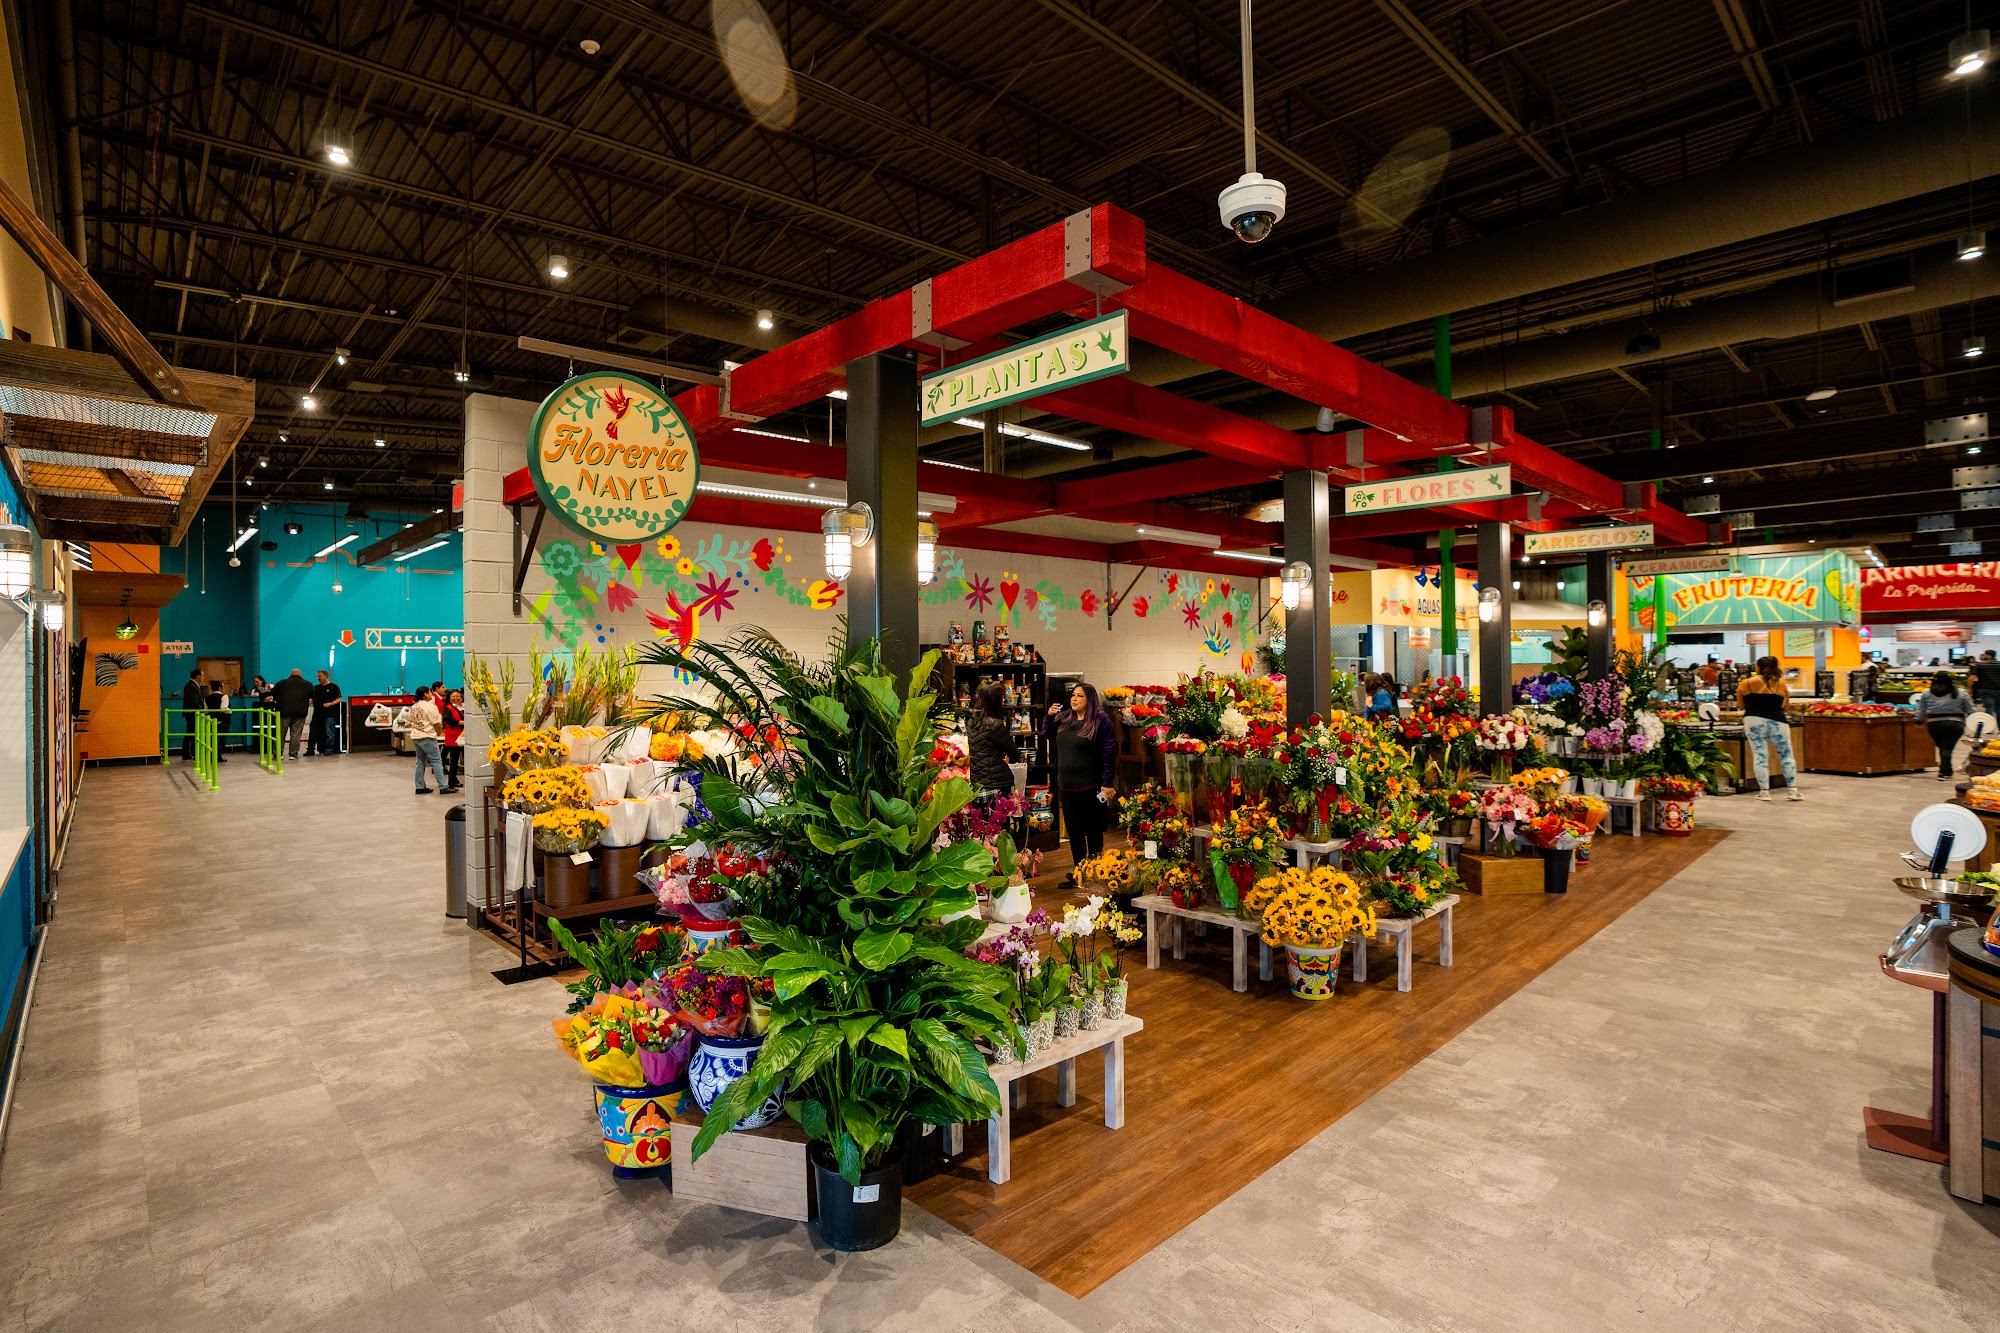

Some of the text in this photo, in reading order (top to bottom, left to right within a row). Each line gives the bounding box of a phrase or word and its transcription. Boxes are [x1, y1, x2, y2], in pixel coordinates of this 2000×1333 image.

[949, 339, 1088, 407] PLANTAS
[577, 468, 677, 501] NAYEL
[1383, 478, 1476, 506] FLORES
[1538, 530, 1640, 550] ARREGLOS
[1638, 559, 1720, 574] CERAMICA
[1672, 576, 1819, 611] FRUTERÍA
[1882, 582, 1990, 600] La Preferida
[1417, 598, 1440, 615] AGUAS
[394, 635, 431, 644] SELF
